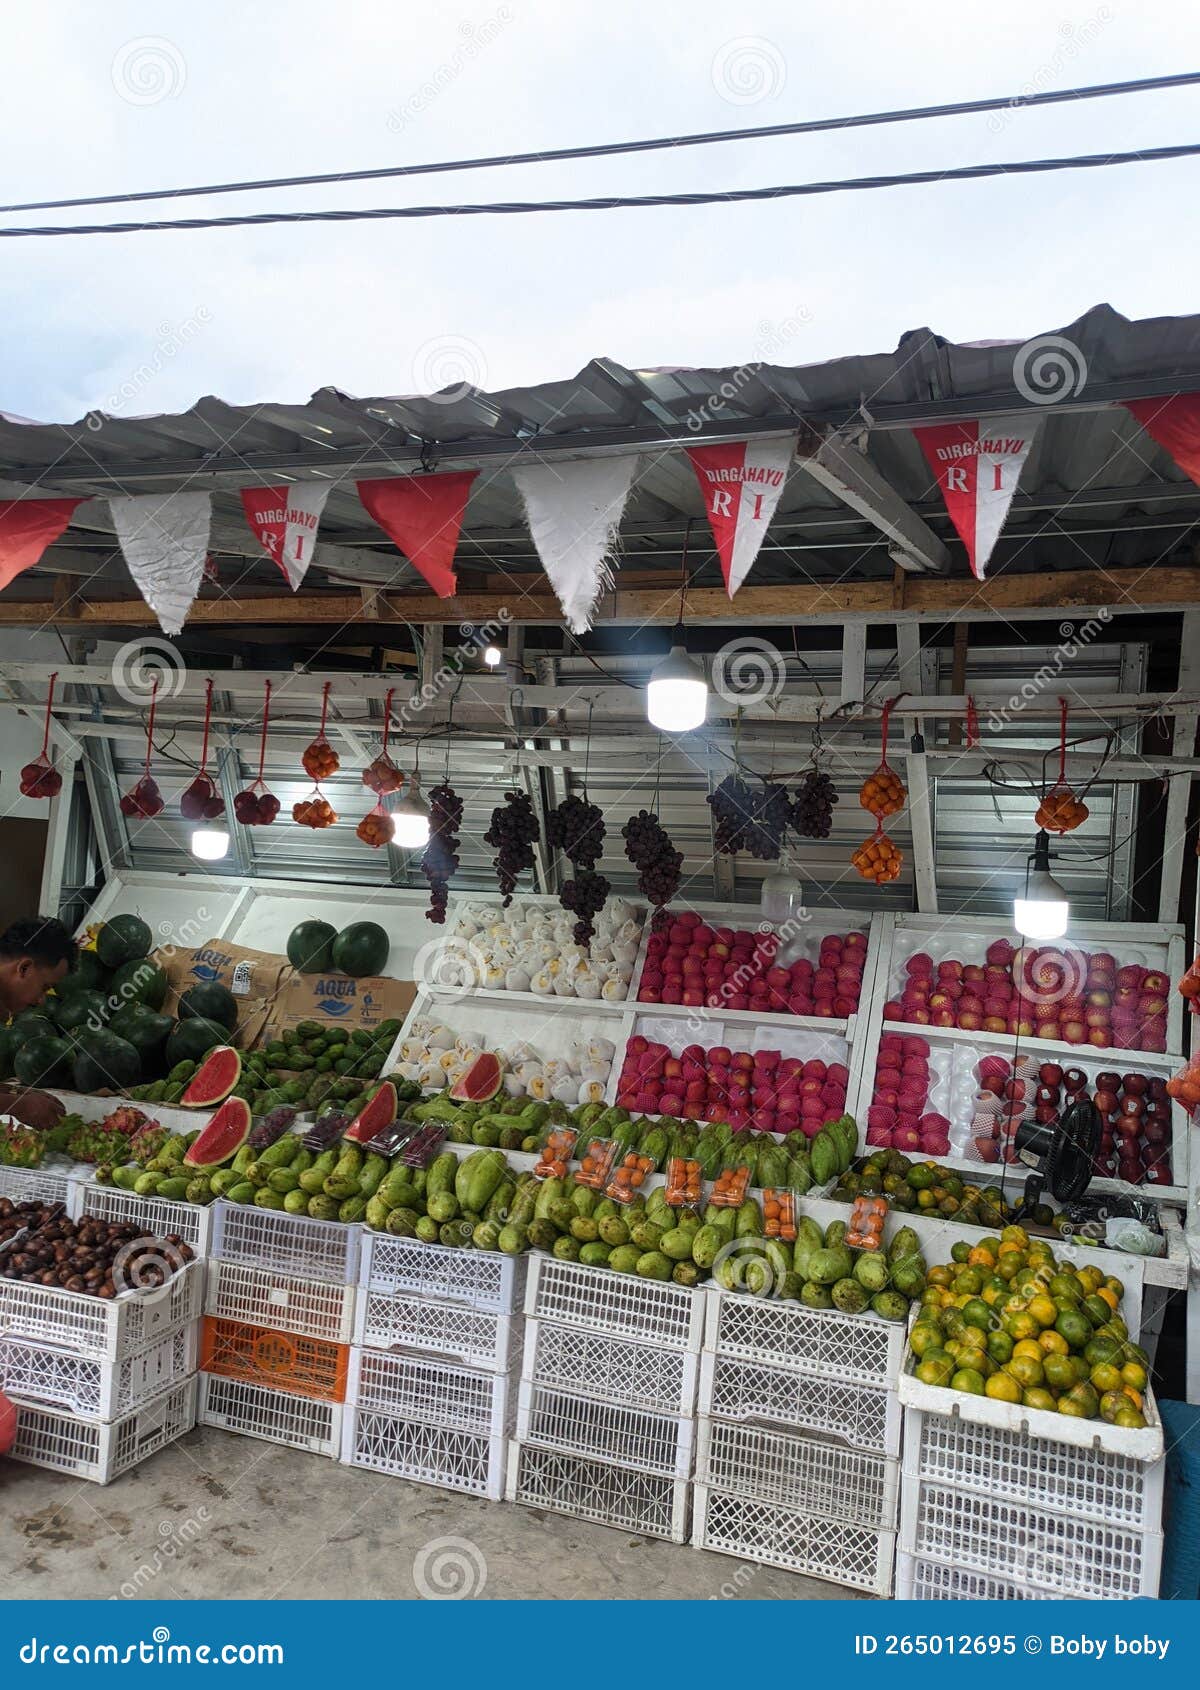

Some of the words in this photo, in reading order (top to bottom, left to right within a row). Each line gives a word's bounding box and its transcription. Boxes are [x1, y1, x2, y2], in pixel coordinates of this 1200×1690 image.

[936, 439, 1025, 460] DIRGAHAYU
[706, 467, 784, 487] DIRGAHAYU
[946, 467, 970, 493] R
[992, 463, 1005, 489] I
[711, 489, 732, 517] R
[752, 494, 765, 520] I
[255, 508, 319, 530] DIRGAHAYU
[262, 530, 278, 552] R
[293, 535, 305, 560] I
[190, 949, 232, 967] AQUA
[314, 980, 356, 998] AQUA
